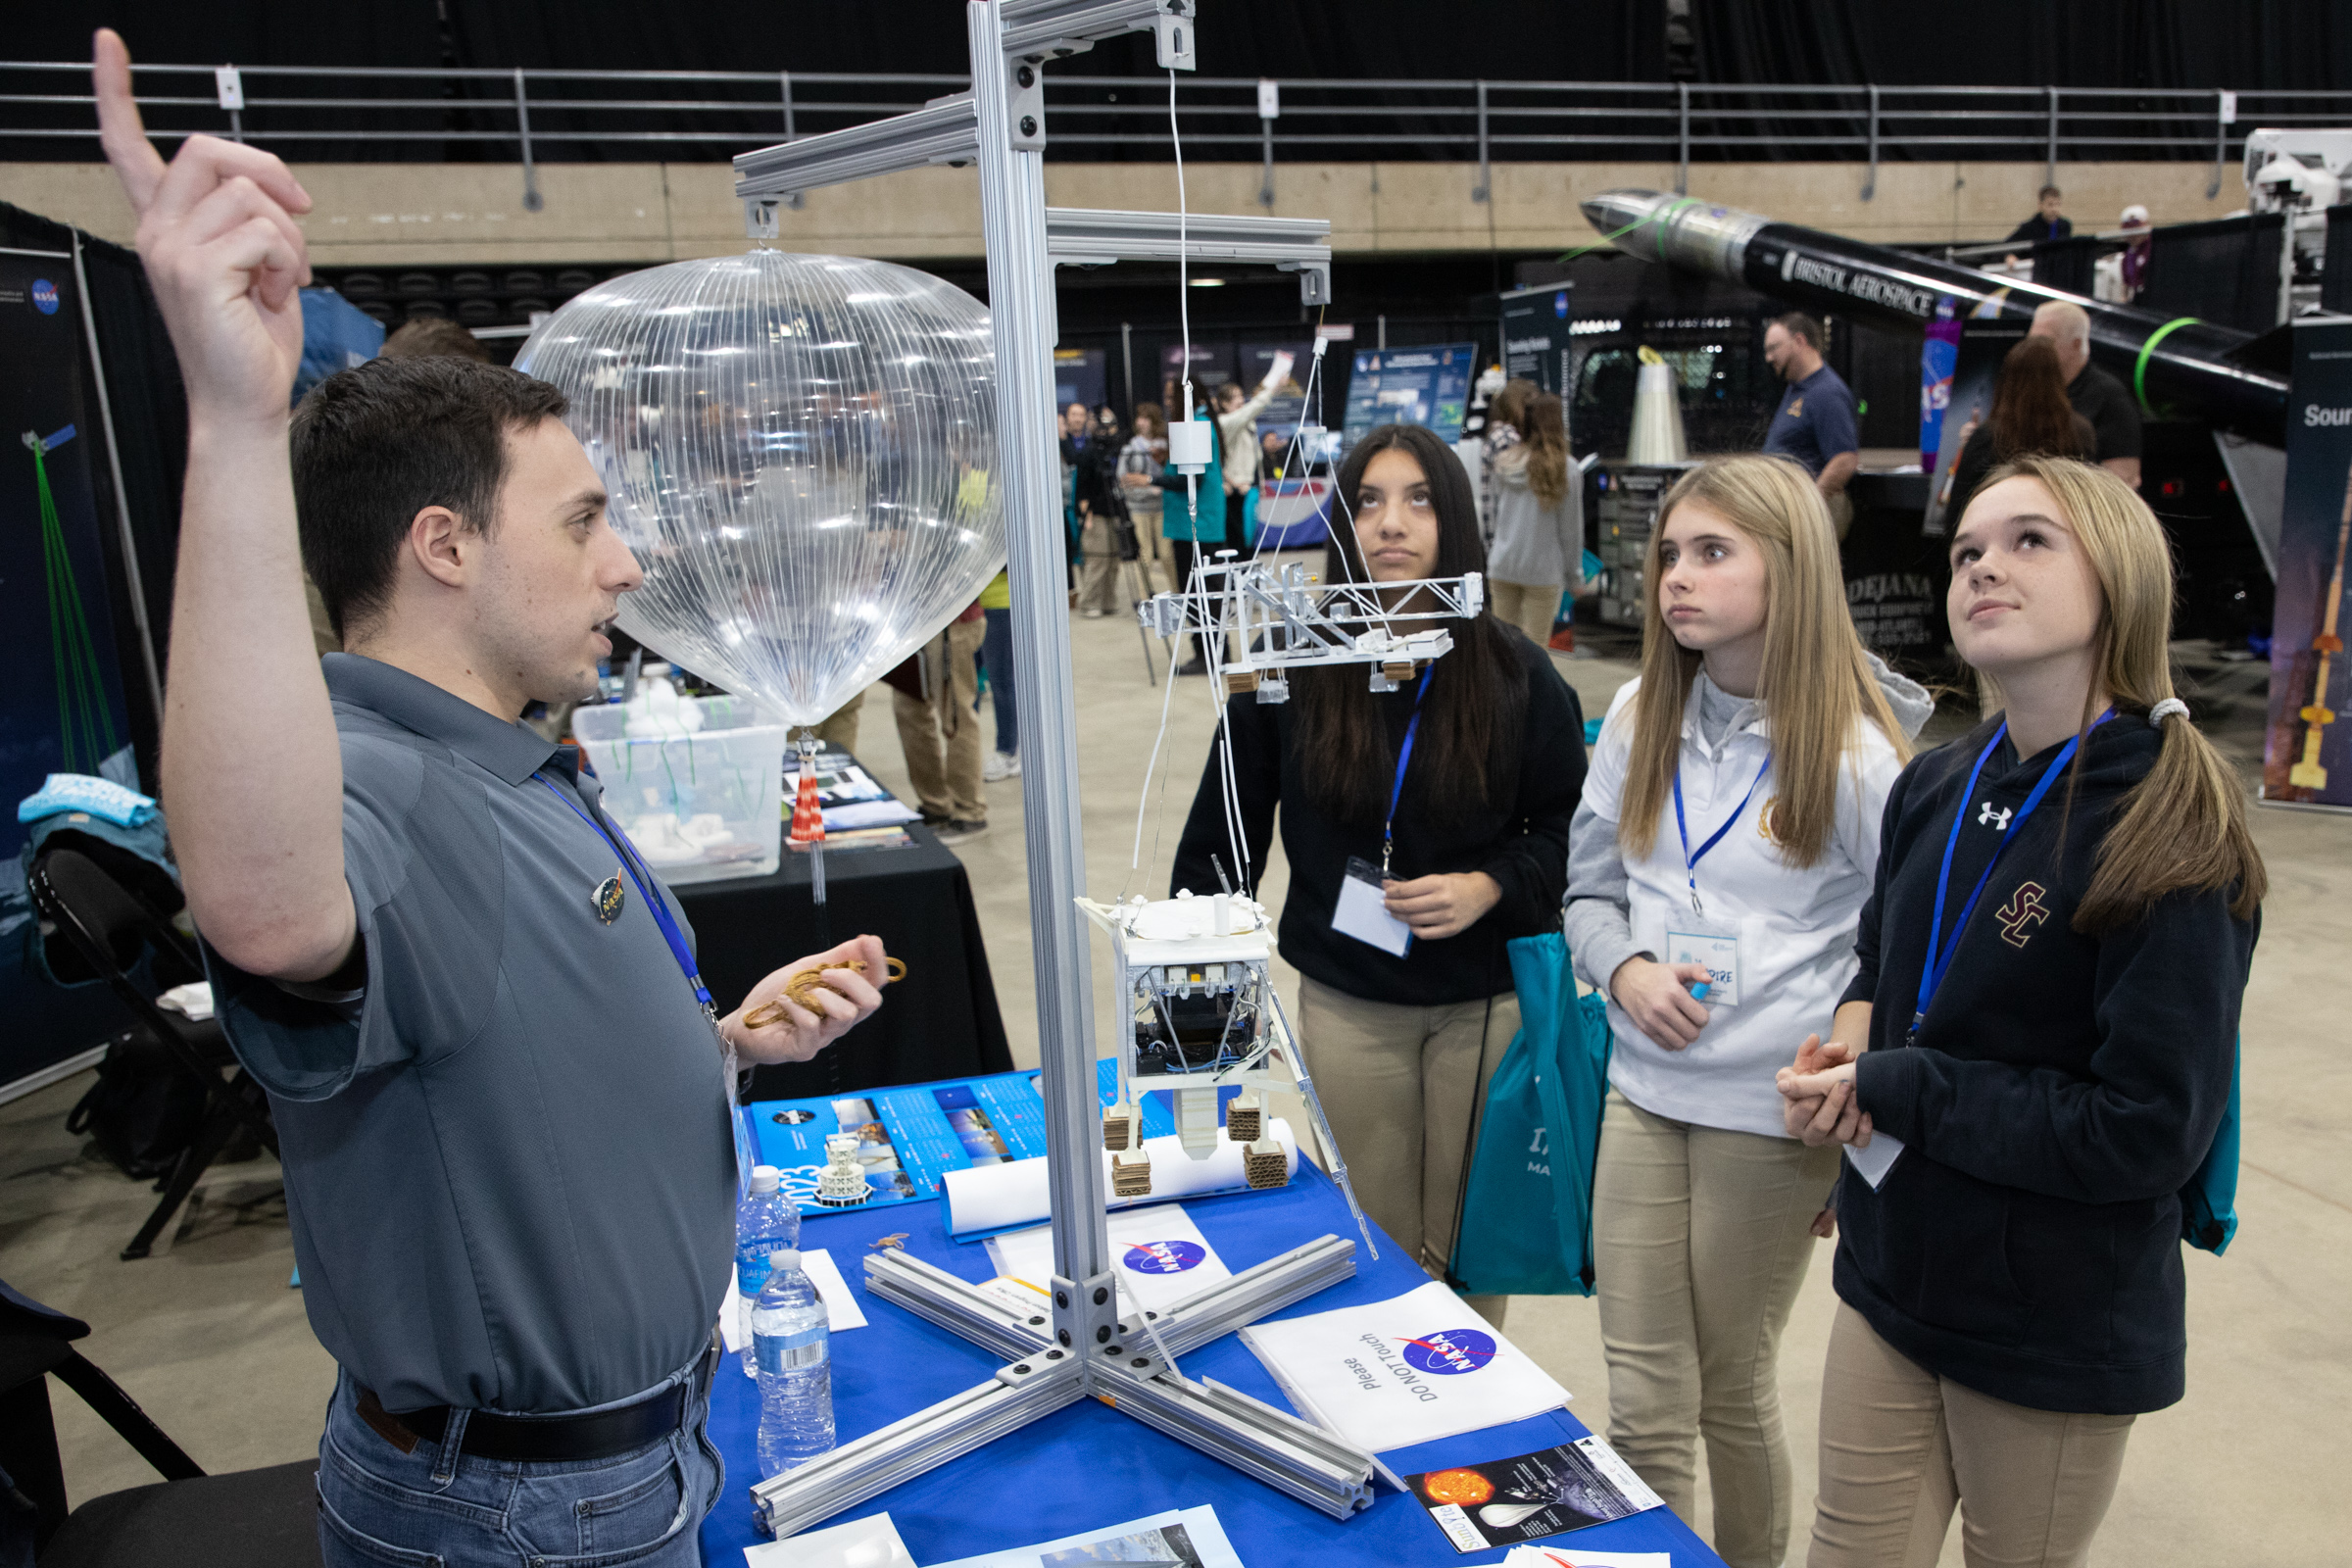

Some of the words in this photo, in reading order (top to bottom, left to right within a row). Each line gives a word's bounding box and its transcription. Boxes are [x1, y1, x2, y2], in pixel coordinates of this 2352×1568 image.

[1793, 257, 1848, 293] BRISTOL
[1847, 272, 1935, 318] AEROSPACE
[602, 887, 624, 913] NASA
[1995, 881, 2051, 949] SC
[1707, 968, 1734, 984] PIRE
[1151, 1241, 1182, 1273] NASA
[1358, 1333, 1396, 1362] Touch
[1428, 1333, 1476, 1372] NASA
[1344, 1357, 1382, 1391] Please
[1386, 1362, 1421, 1385] NOT
[1410, 1385, 1439, 1402] DO
